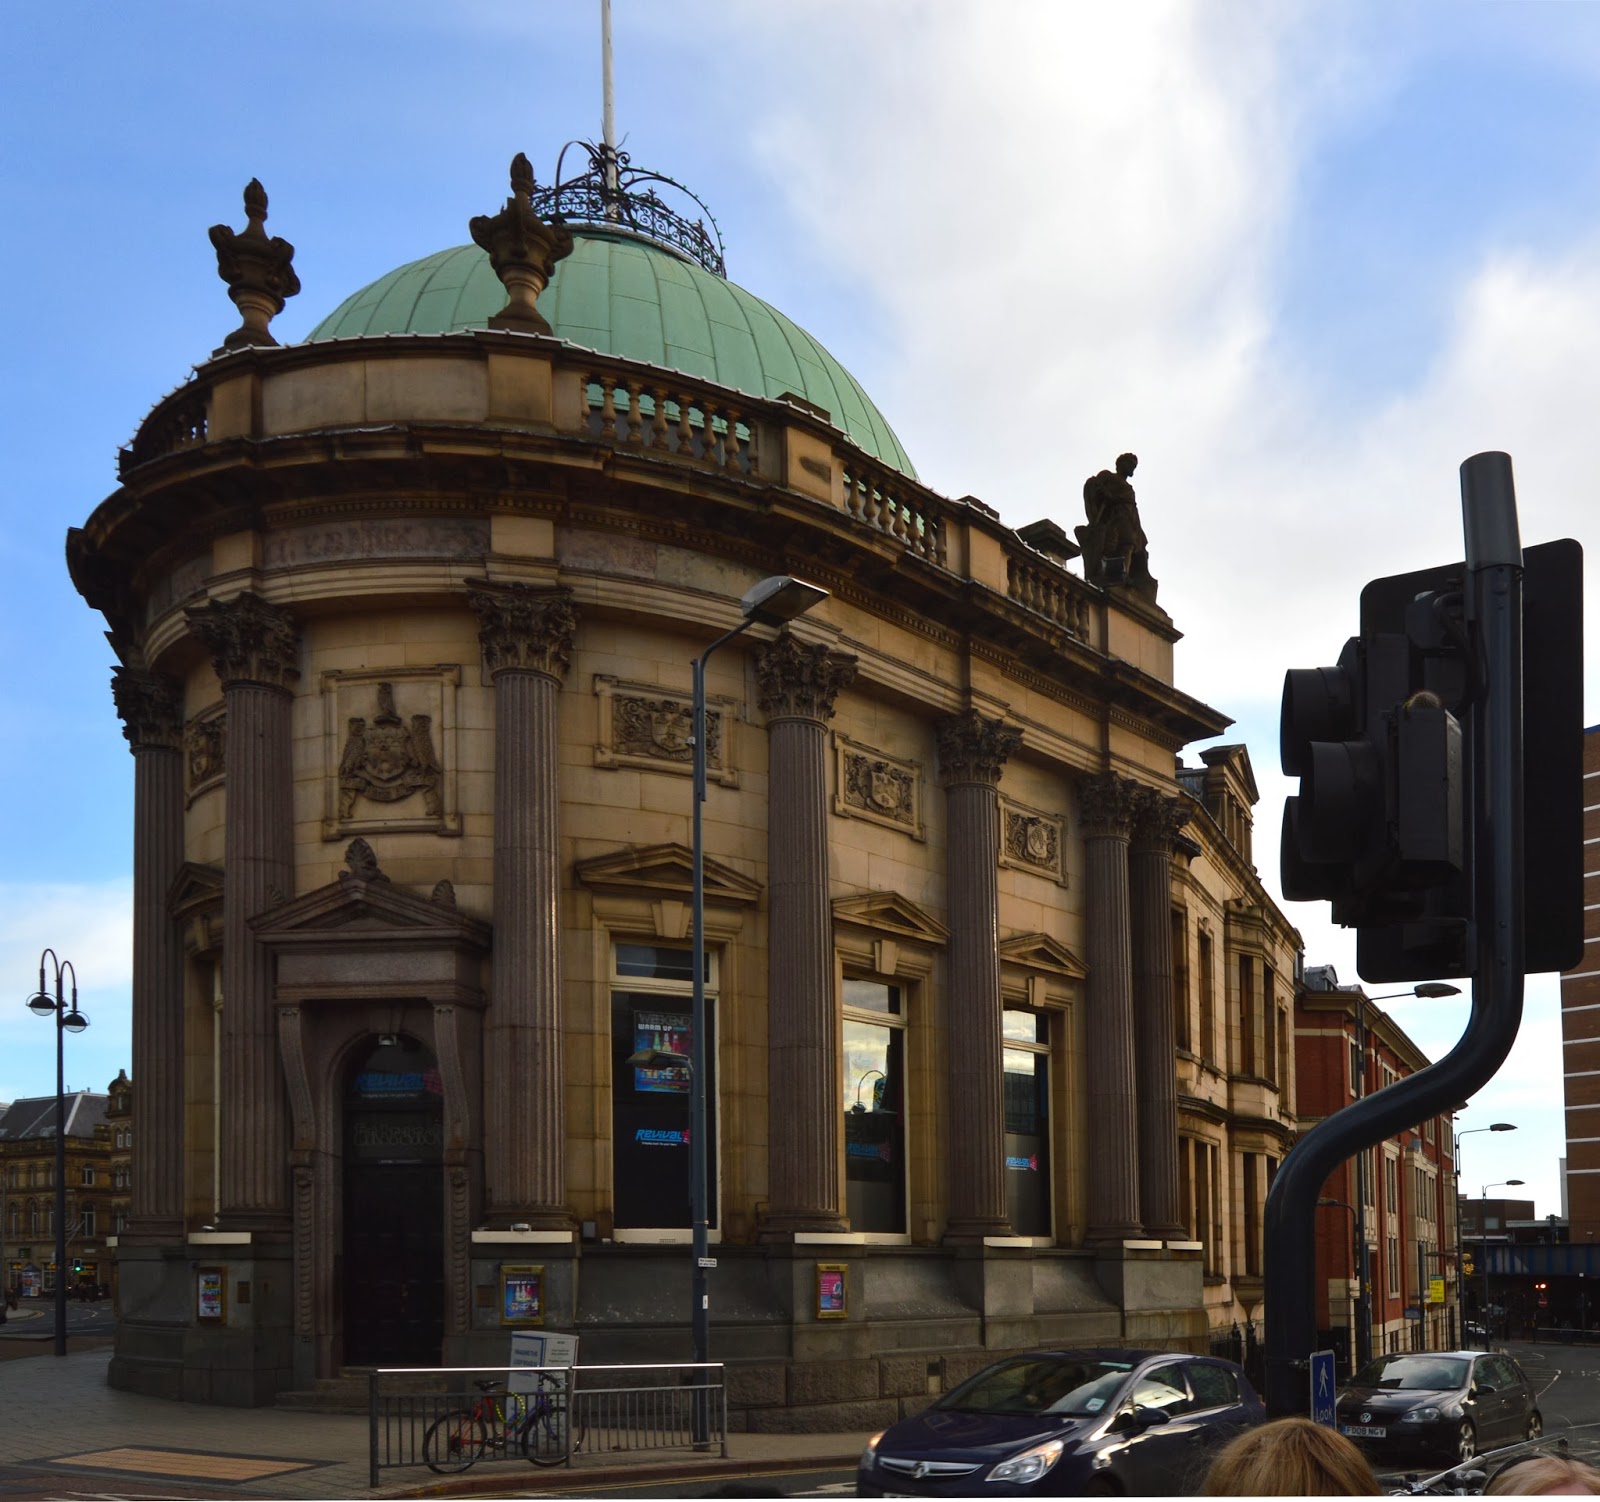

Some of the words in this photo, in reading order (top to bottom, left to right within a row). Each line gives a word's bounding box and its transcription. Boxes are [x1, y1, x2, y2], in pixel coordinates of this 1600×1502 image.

[637, 1023, 662, 1031] WARM
[1315, 1404, 1333, 1422] Look
[1346, 1426, 1367, 1435] FD08
[1368, 1427, 1385, 1436] NGV
